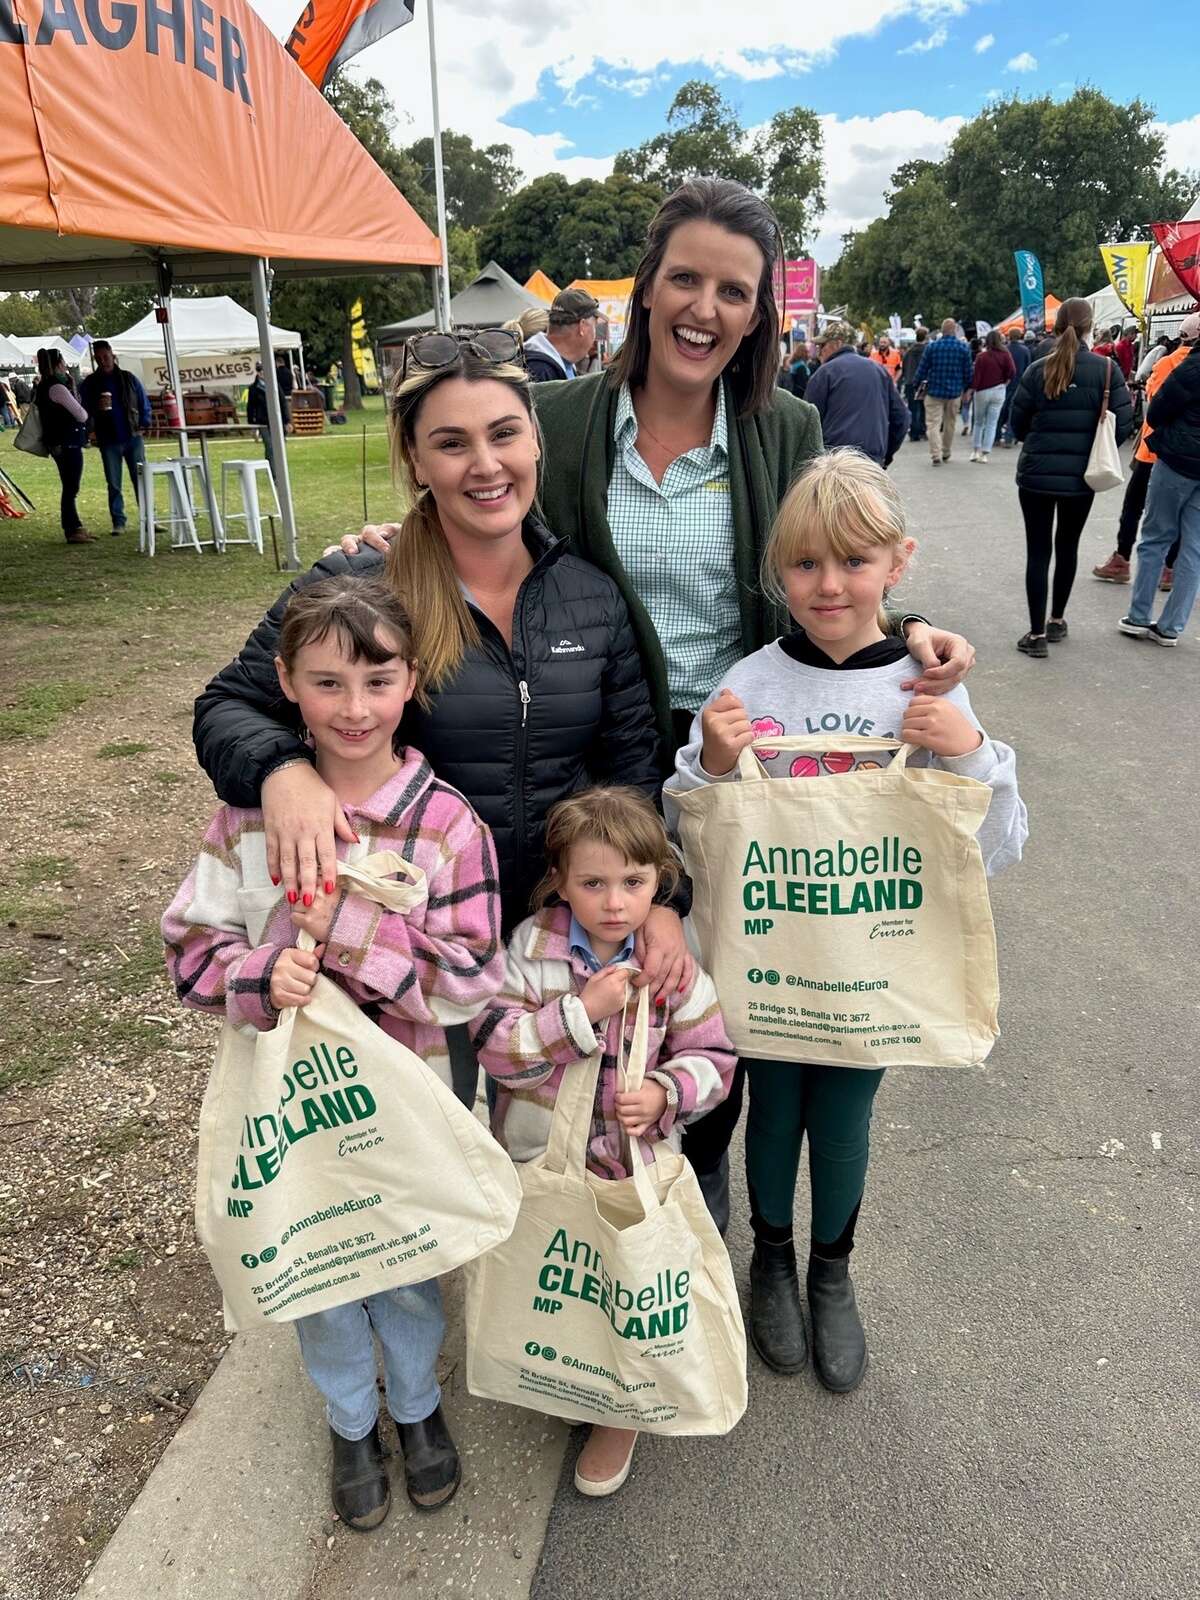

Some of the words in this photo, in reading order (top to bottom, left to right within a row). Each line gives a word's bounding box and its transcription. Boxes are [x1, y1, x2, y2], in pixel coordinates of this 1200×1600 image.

[159, 367, 213, 382] KSTOM
[215, 362, 251, 376] KEGS
[805, 712, 876, 737] LOVE
[742, 836, 922, 877] Annabelle
[742, 878, 924, 915] CLEELAND
[744, 918, 774, 935] MP
[869, 923, 916, 940] Euroa
[785, 974, 889, 993] @Annabelle4Euroa
[747, 1001, 758, 1011] 25
[759, 1002, 786, 1015] Bridge
[787, 1006, 799, 1017] St,
[800, 1008, 831, 1021] Benalla
[833, 1012, 848, 1023] VIC
[849, 1013, 870, 1023] 3672
[870, 1039, 880, 1047] 03
[881, 1036, 900, 1046] 5762
[902, 1036, 921, 1044] 1600
[241, 1042, 359, 1149] nelle
[338, 1135, 385, 1157] Euroa
[227, 1197, 254, 1218] MP
[281, 1193, 383, 1246] @Annabelle4Euroa
[251, 1285, 264, 1295] 25
[265, 1265, 294, 1291] Bridge
[293, 1257, 309, 1269] St,
[307, 1243, 339, 1263] Benalla
[339, 1238, 355, 1251] VIC
[355, 1231, 377, 1246] 3672
[386, 1256, 398, 1267] 03
[398, 1249, 418, 1263] 5762
[418, 1239, 439, 1253] 1600
[533, 1296, 563, 1315] MP
[531, 1371, 557, 1384] Bridge
